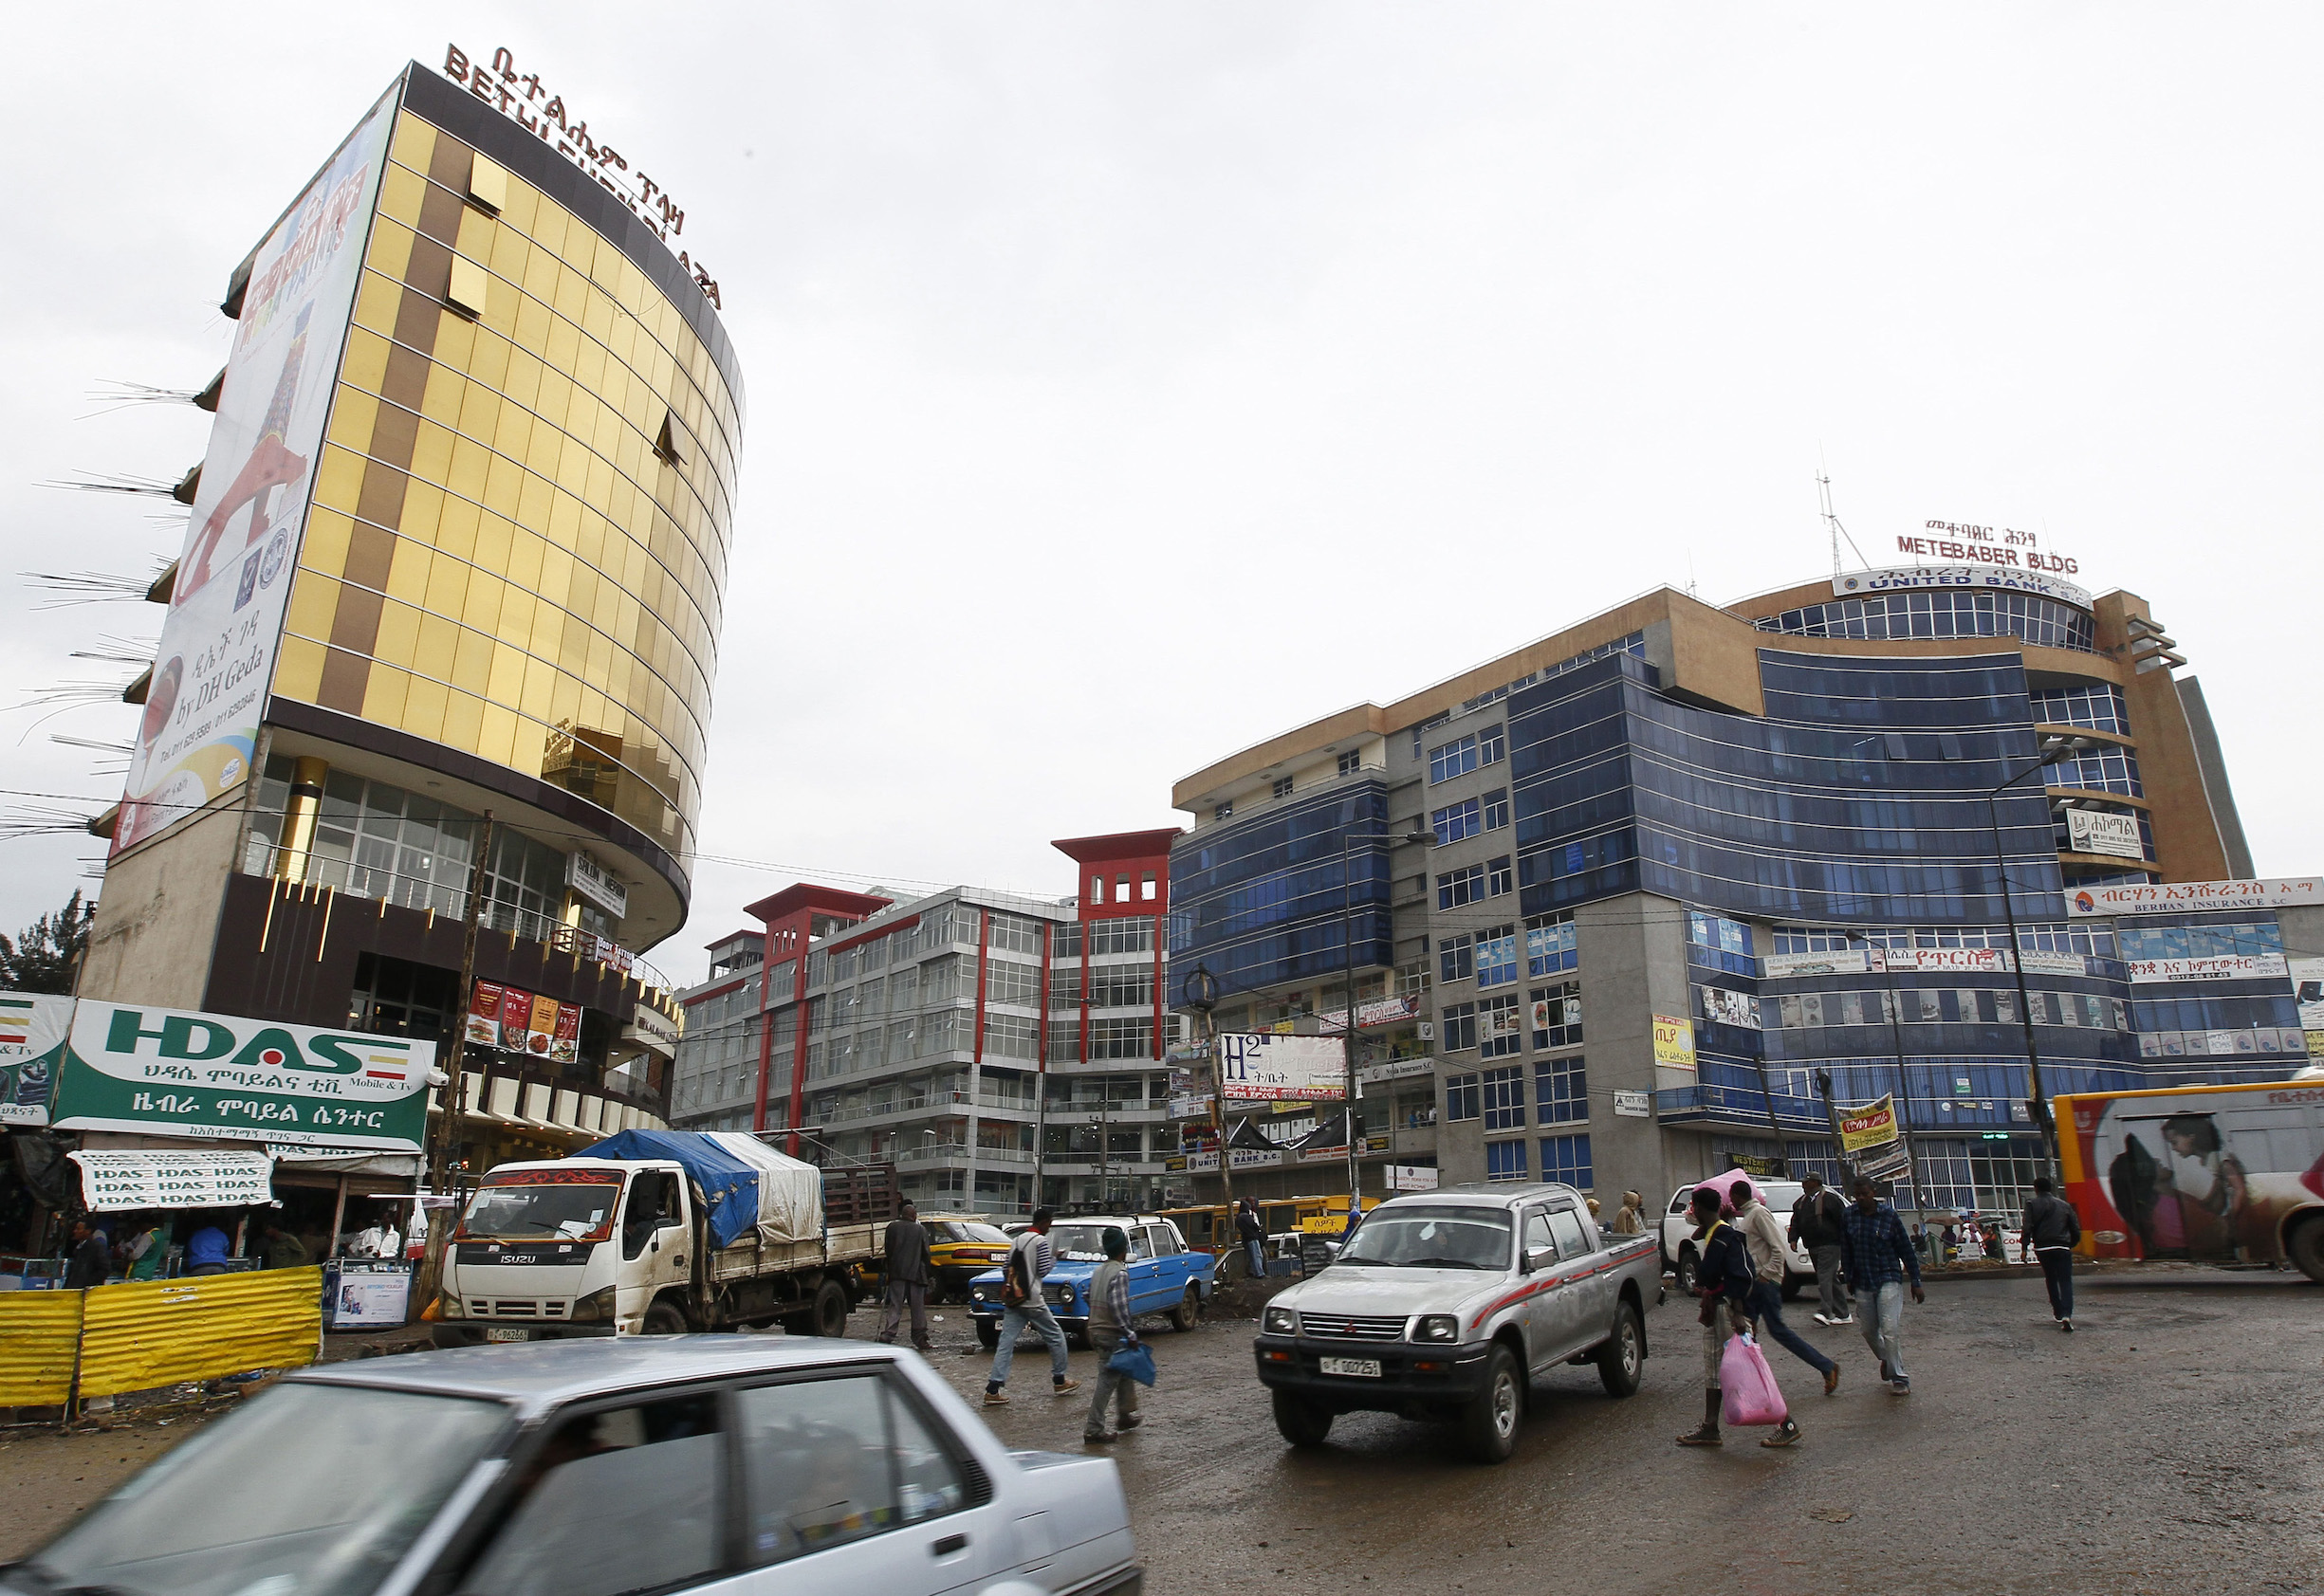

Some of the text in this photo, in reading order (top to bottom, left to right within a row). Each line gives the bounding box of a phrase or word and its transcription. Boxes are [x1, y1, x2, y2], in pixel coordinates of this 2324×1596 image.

[1897, 536, 2078, 574] METEBABER BLDG
[1869, 576, 1972, 589] UNITED
[1985, 577, 2053, 595] BANK
[176, 643, 264, 729] by DH Geda
[2101, 887, 2158, 902] ብርሃን
[2167, 882, 2265, 900] ኢንሹራንስ
[2134, 902, 2185, 912] BERHAN
[2192, 898, 2264, 909] INSURANCE
[2163, 962, 2180, 974] እና
[2187, 958, 2253, 973] ኮምፒውተር
[1399, 1064, 1423, 1073] Insurance
[144, 1064, 342, 1094] ህዳሴ ሞባይልና ቲቪ
[349, 1077, 384, 1089] Mobile
[399, 1082, 413, 1092] Tv
[133, 1092, 384, 1128] ዜብራ ሞባይል ሴንተር
[189, 1126, 260, 1138] ከአስተማማኝ
[298, 1134, 316, 1143] ጋር
[1234, 1154, 1259, 1164] BANK
[501, 1255, 537, 1264] ISUZU
